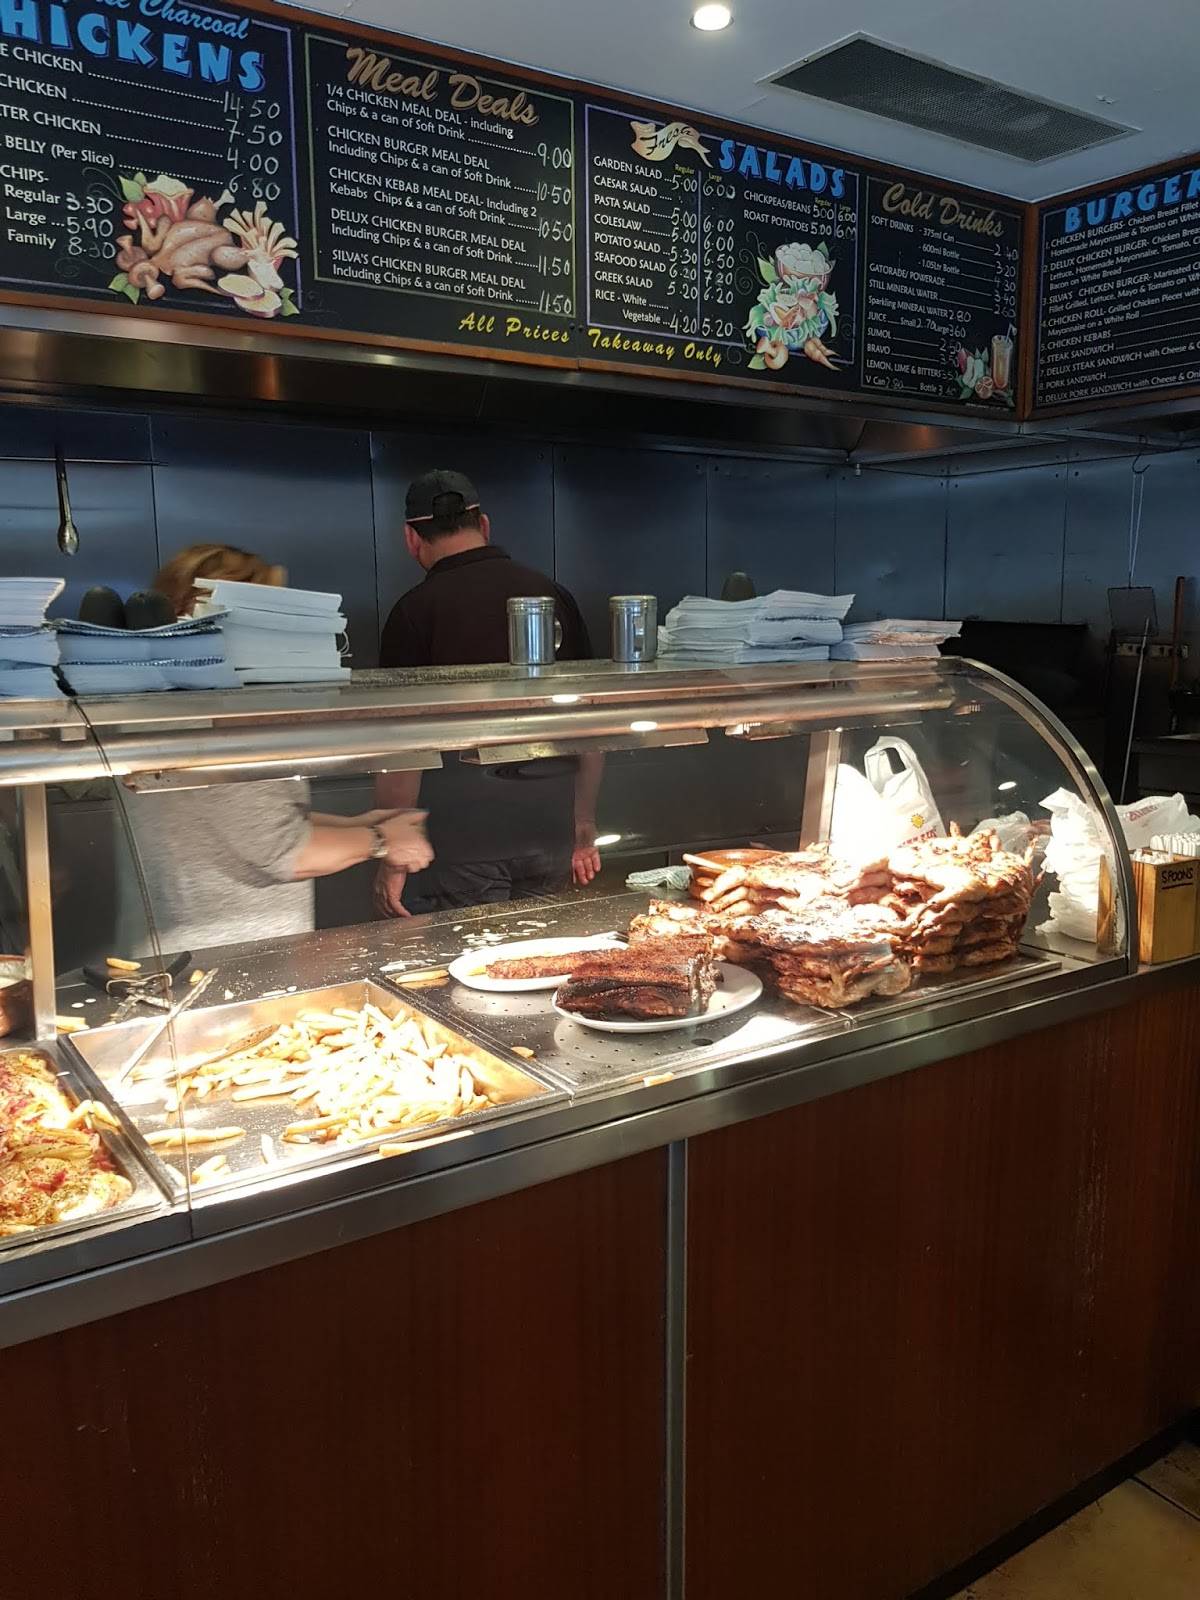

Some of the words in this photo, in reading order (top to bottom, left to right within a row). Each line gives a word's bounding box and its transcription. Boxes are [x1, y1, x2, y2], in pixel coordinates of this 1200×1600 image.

[139, 0, 249, 39] Charcoal
[13, 46, 83, 73] CHICKEN
[346, 47, 438, 101] Meal
[449, 74, 539, 125] Deals
[327, 83, 343, 97] 1/4
[346, 88, 398, 110] CHICKEN
[402, 101, 432, 118] MEAL
[435, 108, 462, 125] DEAL
[470, 117, 514, 139] including
[33, 111, 101, 135] CHICKEN
[227, 147, 279, 174] 4.00
[225, 119, 283, 145] 7.50
[327, 99, 356, 116] Chips
[416, 120, 435, 133] Soft
[439, 124, 465, 140] Drink
[537, 142, 571, 168] 9.00
[327, 125, 380, 146] CHICKEN
[384, 136, 429, 157] BURGER
[432, 147, 461, 164] MEAL
[464, 154, 490, 170] DEAL
[5, 135, 46, 154] BELLY
[51, 143, 77, 159] (Per
[81, 149, 114, 168] Slice)
[229, 174, 280, 200] 6.80
[328, 140, 377, 163] Including
[380, 151, 408, 168] Chips
[464, 169, 482, 182] Soft
[485, 173, 511, 188] Drink
[594, 156, 632, 173] GARDEN
[635, 165, 662, 179] SALAD
[718, 139, 846, 198] SALADS
[4, 184, 60, 204] Regular
[66, 192, 113, 214] 3.30
[329, 167, 381, 187] CHICKEN
[385, 177, 419, 194] KEBAB
[422, 185, 452, 201] MEAL
[487, 197, 528, 217] Including
[531, 206, 537, 217] 2
[594, 175, 628, 191] CAESAR
[630, 182, 657, 197] SALAD
[330, 181, 368, 199] Kebabs
[374, 190, 402, 206] Chips
[458, 206, 477, 220] Soft
[479, 210, 506, 225] Drink
[594, 194, 620, 209] PASTA
[623, 200, 650, 214] SALAD
[743, 190, 811, 214] CHICKPEAS/BEANS
[882, 183, 934, 219] Cold
[939, 197, 1004, 237] Drinks
[6, 207, 46, 225] Large
[67, 216, 113, 238] 5.90
[331, 208, 368, 225] DELUX
[371, 215, 421, 233] CHICKEN
[425, 224, 468, 242] BURGER
[470, 232, 499, 248] MEAL
[501, 238, 526, 252] DEAL
[594, 213, 642, 231] COLESLAW
[743, 209, 770, 223] ROAST
[771, 215, 808, 232] POTATOES
[871, 215, 888, 226] SOFT
[889, 219, 914, 233] DRINKS
[1051, 232, 1085, 248] CHICKEN
[1128, 214, 1155, 227] Chicken
[7, 228, 56, 249] Family
[331, 223, 380, 244] Including
[382, 232, 410, 248] Chips
[465, 246, 484, 260] Soft
[487, 249, 513, 264] Drink
[594, 232, 631, 248] POTATO
[633, 239, 661, 253] SALAD
[1050, 258, 1075, 271] DELUX
[1076, 247, 1112, 264] CHICKEN
[1152, 232, 1180, 245] Chicken
[594, 251, 637, 267] SEAFOOD
[639, 259, 666, 272] SALAD
[943, 248, 960, 260] Bottle
[332, 249, 368, 265] SILVA'S
[371, 255, 421, 273] CHICKEN
[425, 263, 468, 281] BURGER
[470, 271, 499, 286] MEAL
[501, 275, 526, 289] DEAL
[333, 263, 380, 284] Including
[383, 272, 411, 287] Chips
[466, 284, 485, 297] Soft
[488, 287, 514, 301] Drink
[594, 270, 624, 284] GREEK
[625, 275, 653, 288] SALAD
[910, 271, 946, 286] POWERADE
[595, 289, 615, 301] RICE
[622, 293, 647, 306] White
[869, 278, 885, 289] STILL
[887, 282, 915, 296] MINERAL
[916, 288, 938, 300] WATER
[622, 309, 661, 323] Vegetable
[897, 301, 926, 314] MINERAL
[926, 306, 948, 318] WATER
[1048, 312, 1082, 327] CHICKEN
[459, 311, 495, 332] All
[505, 317, 570, 343] Prices
[587, 328, 675, 360] Takeaway
[684, 342, 722, 368] Only
[1047, 336, 1081, 350] CHICKEN
[1070, 343, 1114, 359] SANDWICH
[1097, 351, 1142, 367] SANDWICH
[1161, 867, 1194, 883] SPOONS
